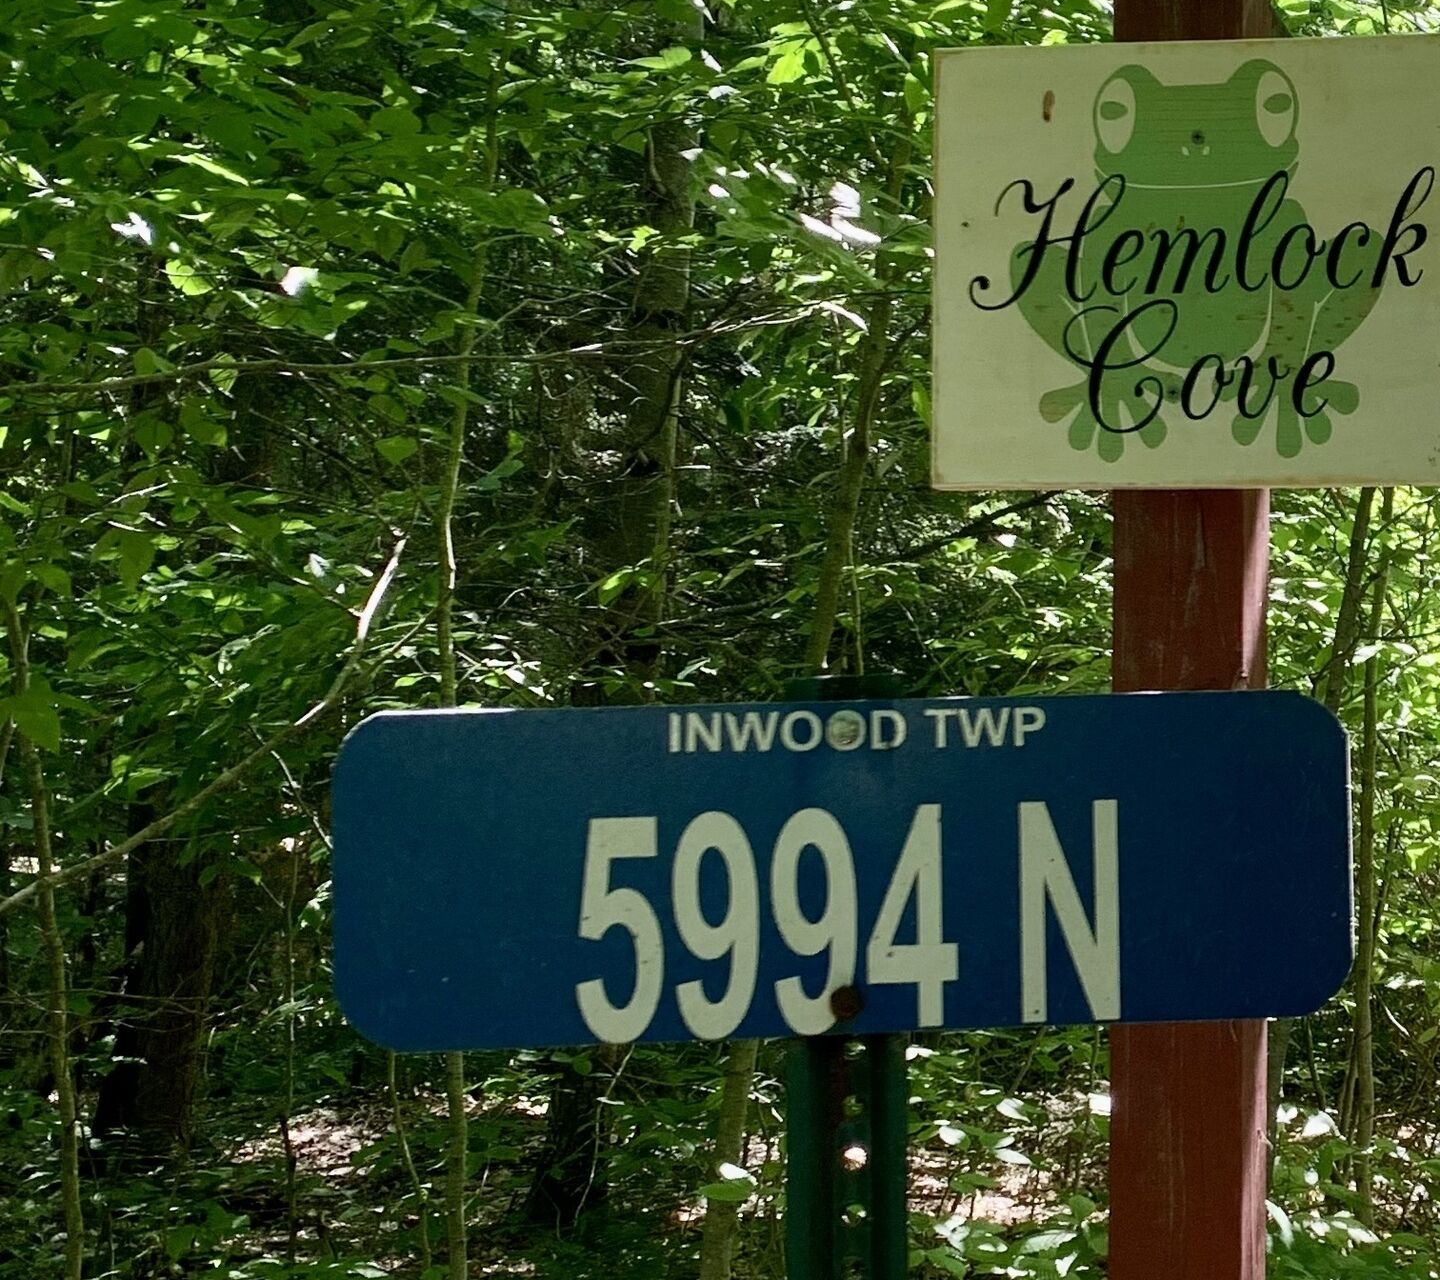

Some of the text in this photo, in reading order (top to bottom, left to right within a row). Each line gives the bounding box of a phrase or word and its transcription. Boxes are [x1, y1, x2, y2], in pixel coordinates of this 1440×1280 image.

[968, 166, 1436, 310] Hemlock
[1062, 298, 1336, 433] Cove
[668, 706, 1046, 753] INWOOD TWP
[575, 799, 1121, 1046] 5994 N
